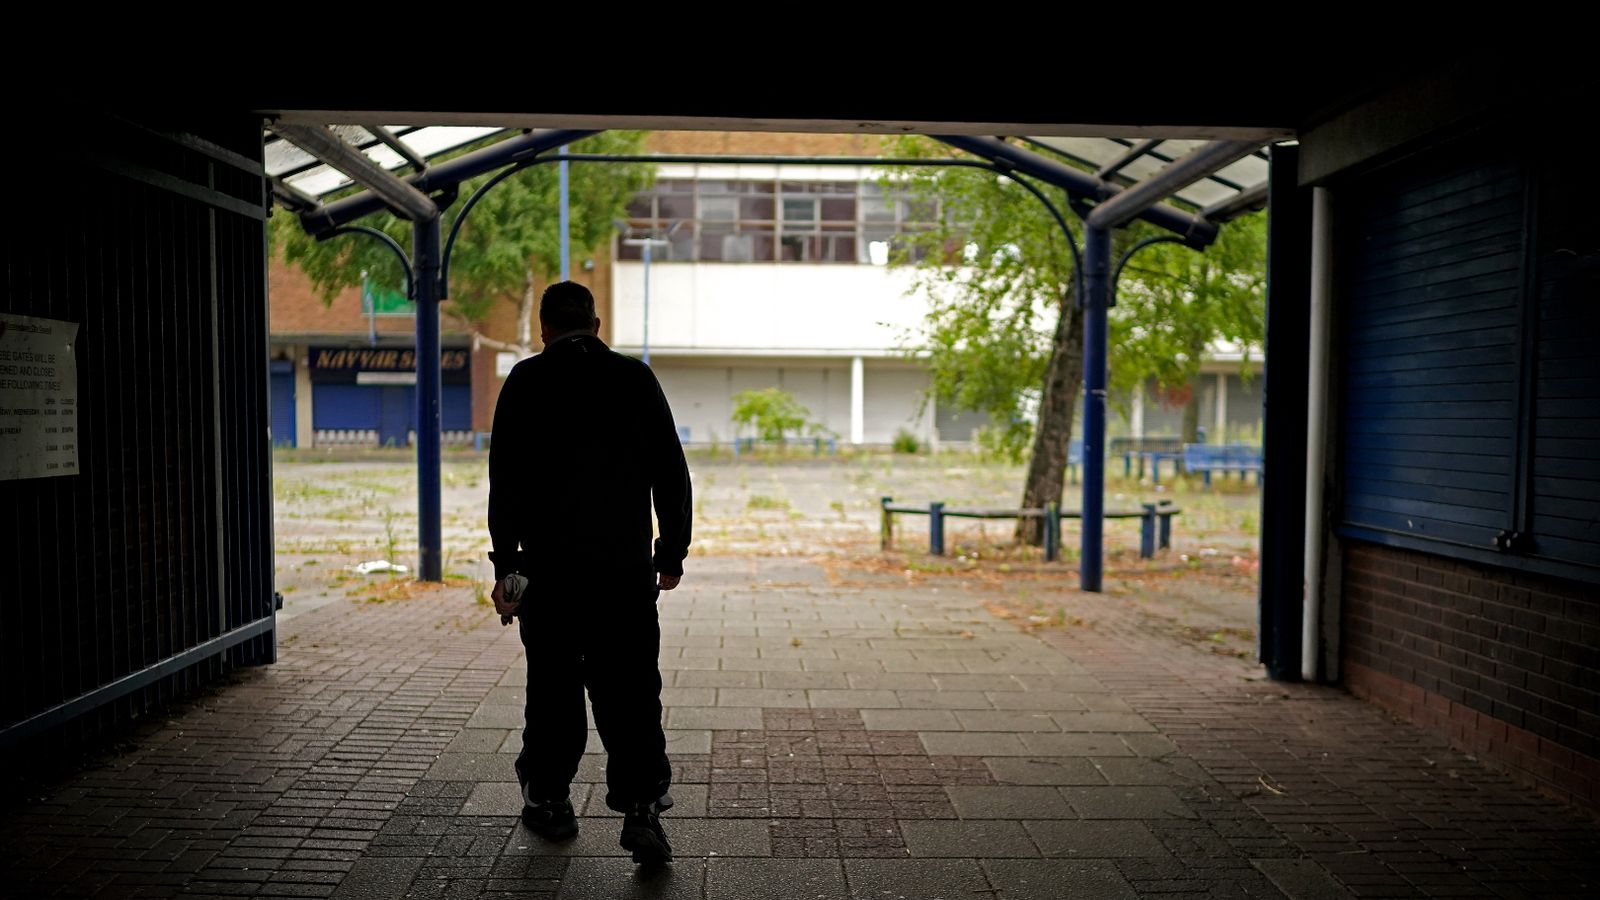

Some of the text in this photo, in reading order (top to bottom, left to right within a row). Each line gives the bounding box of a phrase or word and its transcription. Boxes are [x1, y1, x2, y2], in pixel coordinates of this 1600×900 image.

[12, 351, 34, 362] GATES
[48, 354, 56, 364] BE
[316, 350, 467, 368] NAYYAR SES
